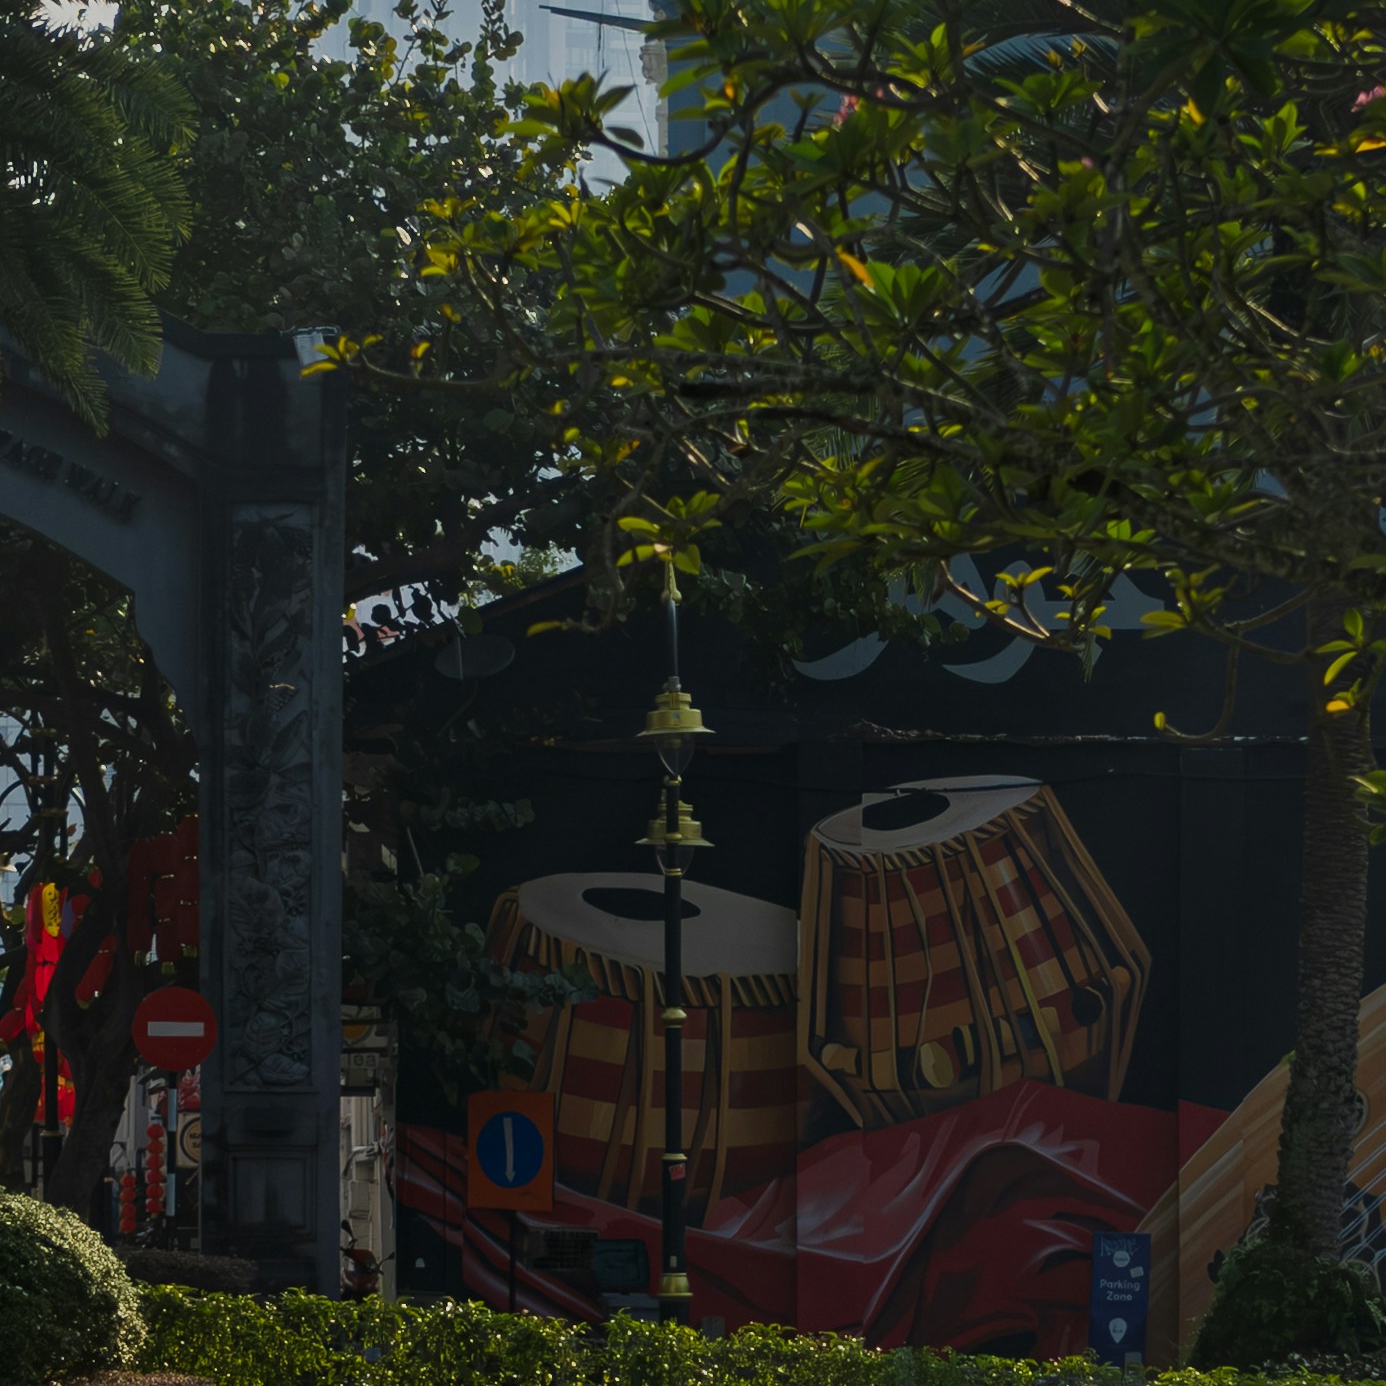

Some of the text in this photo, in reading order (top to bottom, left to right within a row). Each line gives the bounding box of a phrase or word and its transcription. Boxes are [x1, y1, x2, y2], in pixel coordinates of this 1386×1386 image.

[66, 461, 142, 525] WALK
[1099, 1279, 1141, 1291] Parking
[1106, 1290, 1133, 1301] Zone
